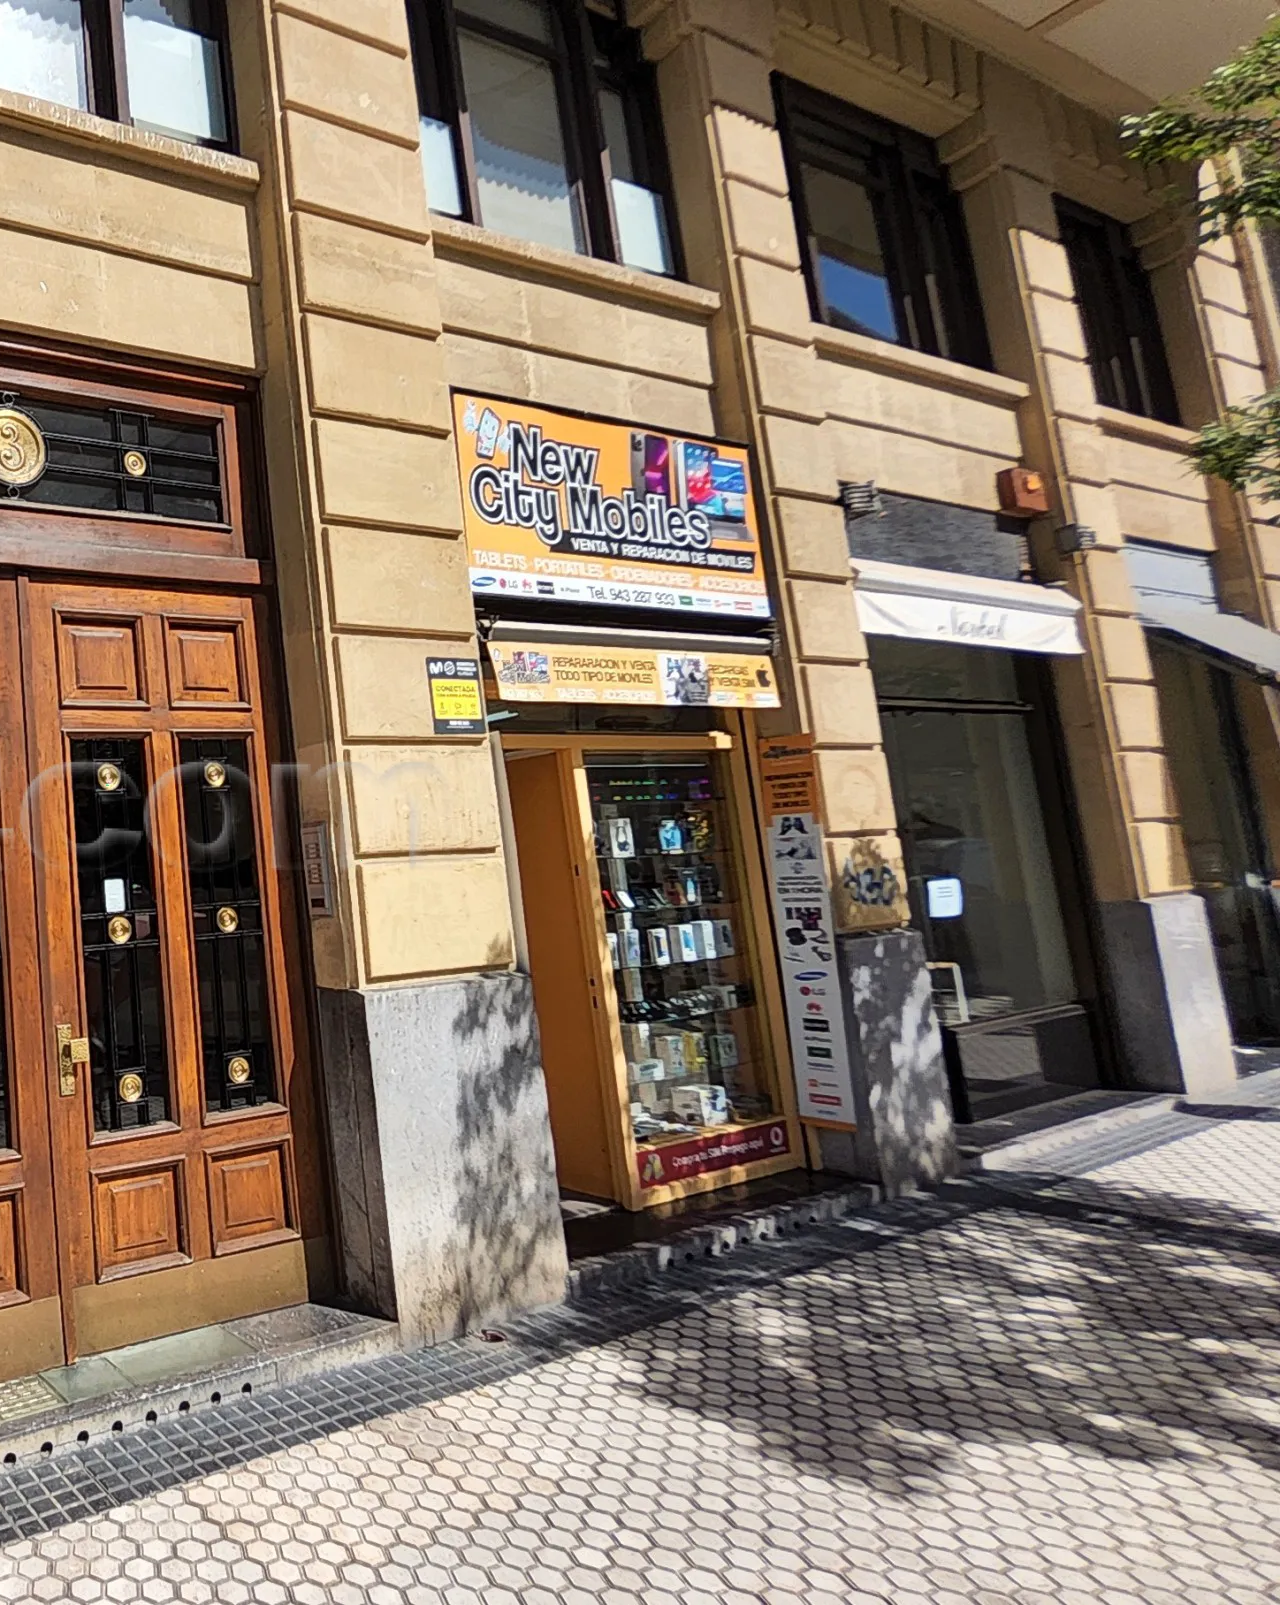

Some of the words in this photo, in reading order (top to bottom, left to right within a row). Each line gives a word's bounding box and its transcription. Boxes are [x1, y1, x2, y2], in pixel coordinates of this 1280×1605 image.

[507, 420, 600, 485] New
[469, 463, 563, 546] City
[568, 484, 713, 549] Mobiles
[472, 549, 529, 571] TABLETS
[534, 557, 605, 579] PORTATILES
[571, 537, 610, 554] VENTA
[610, 542, 620, 555] Y
[690, 551, 707, 565] DE
[508, 580, 519, 589] LG
[609, 588, 631, 603] 943
[554, 669, 580, 682] TODO
[581, 670, 603, 682] TIPO
